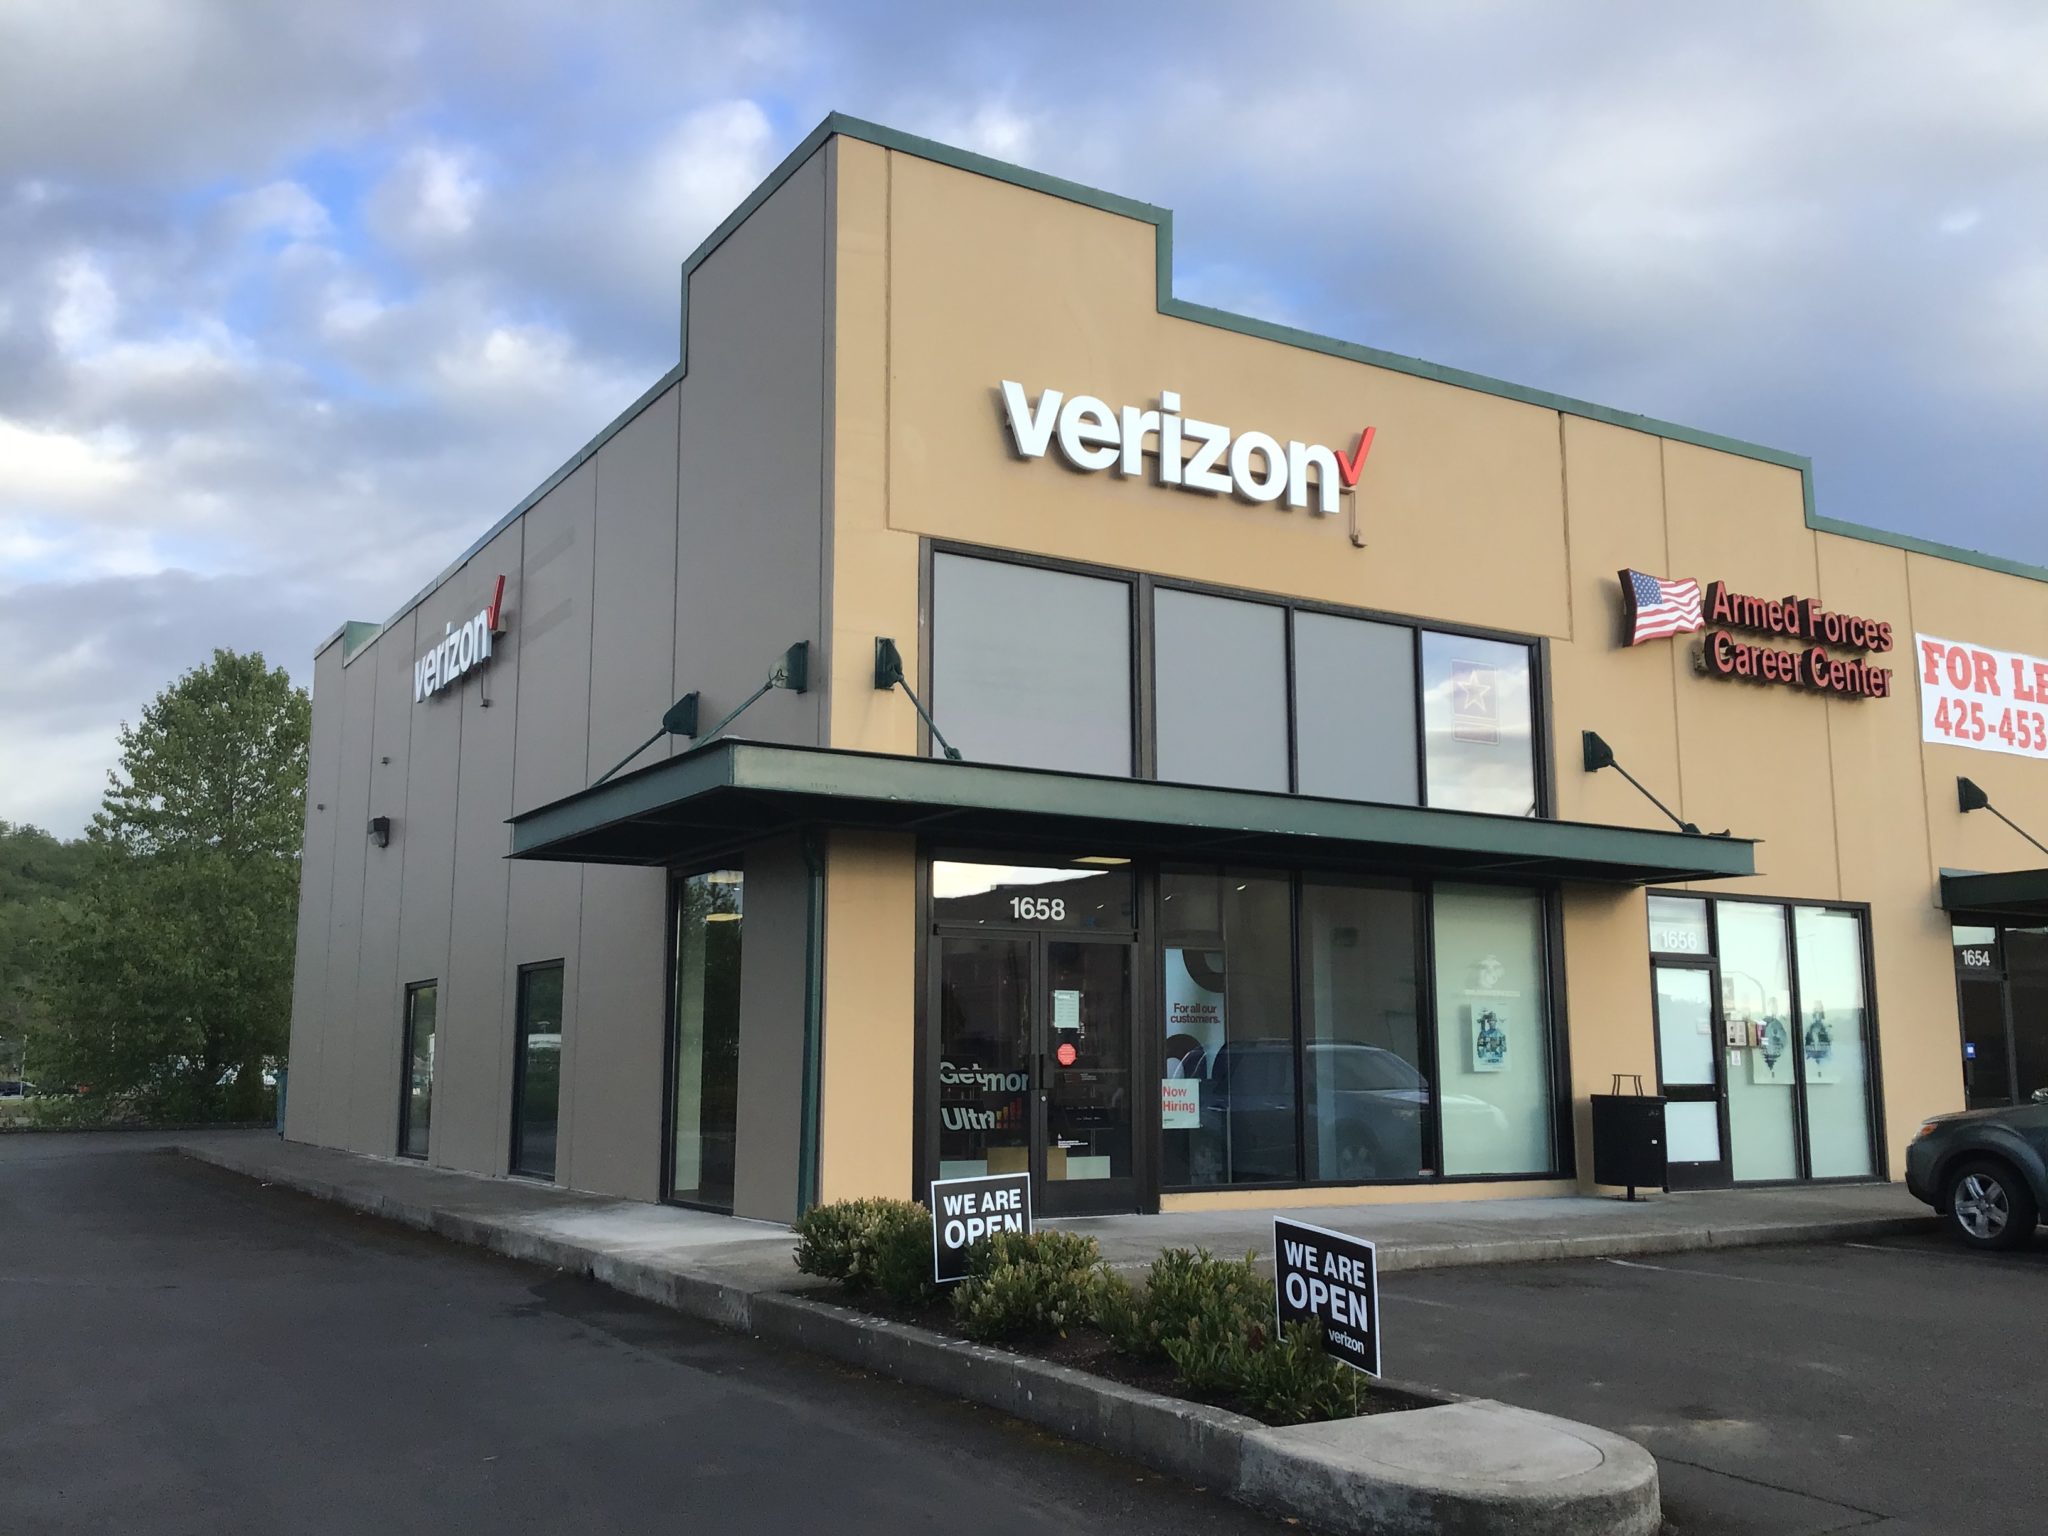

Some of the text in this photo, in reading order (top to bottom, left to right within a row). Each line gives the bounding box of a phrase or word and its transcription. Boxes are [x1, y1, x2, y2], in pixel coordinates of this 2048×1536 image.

[1001, 379, 1341, 514] verizon
[1707, 580, 1894, 653] Armed Forces
[414, 608, 492, 703] verizon
[1707, 629, 1894, 698] Career Center
[1921, 640, 2001, 697] FOR
[1934, 696, 2047, 752] 425-453
[1009, 896, 1066, 921] 1658
[1662, 930, 1698, 951] 1656
[1961, 949, 1991, 967] 1654
[1170, 1014, 1221, 1024] customers.
[1173, 1003, 1217, 1014] For all our
[1162, 1086, 1187, 1097] Now
[1162, 1101, 1196, 1114] Hiring
[943, 1188, 1022, 1217] WE ARE
[1283, 1239, 1366, 1290] WE ARE
[1285, 1271, 1369, 1333] OPEN
[1328, 1328, 1365, 1355] verizon
